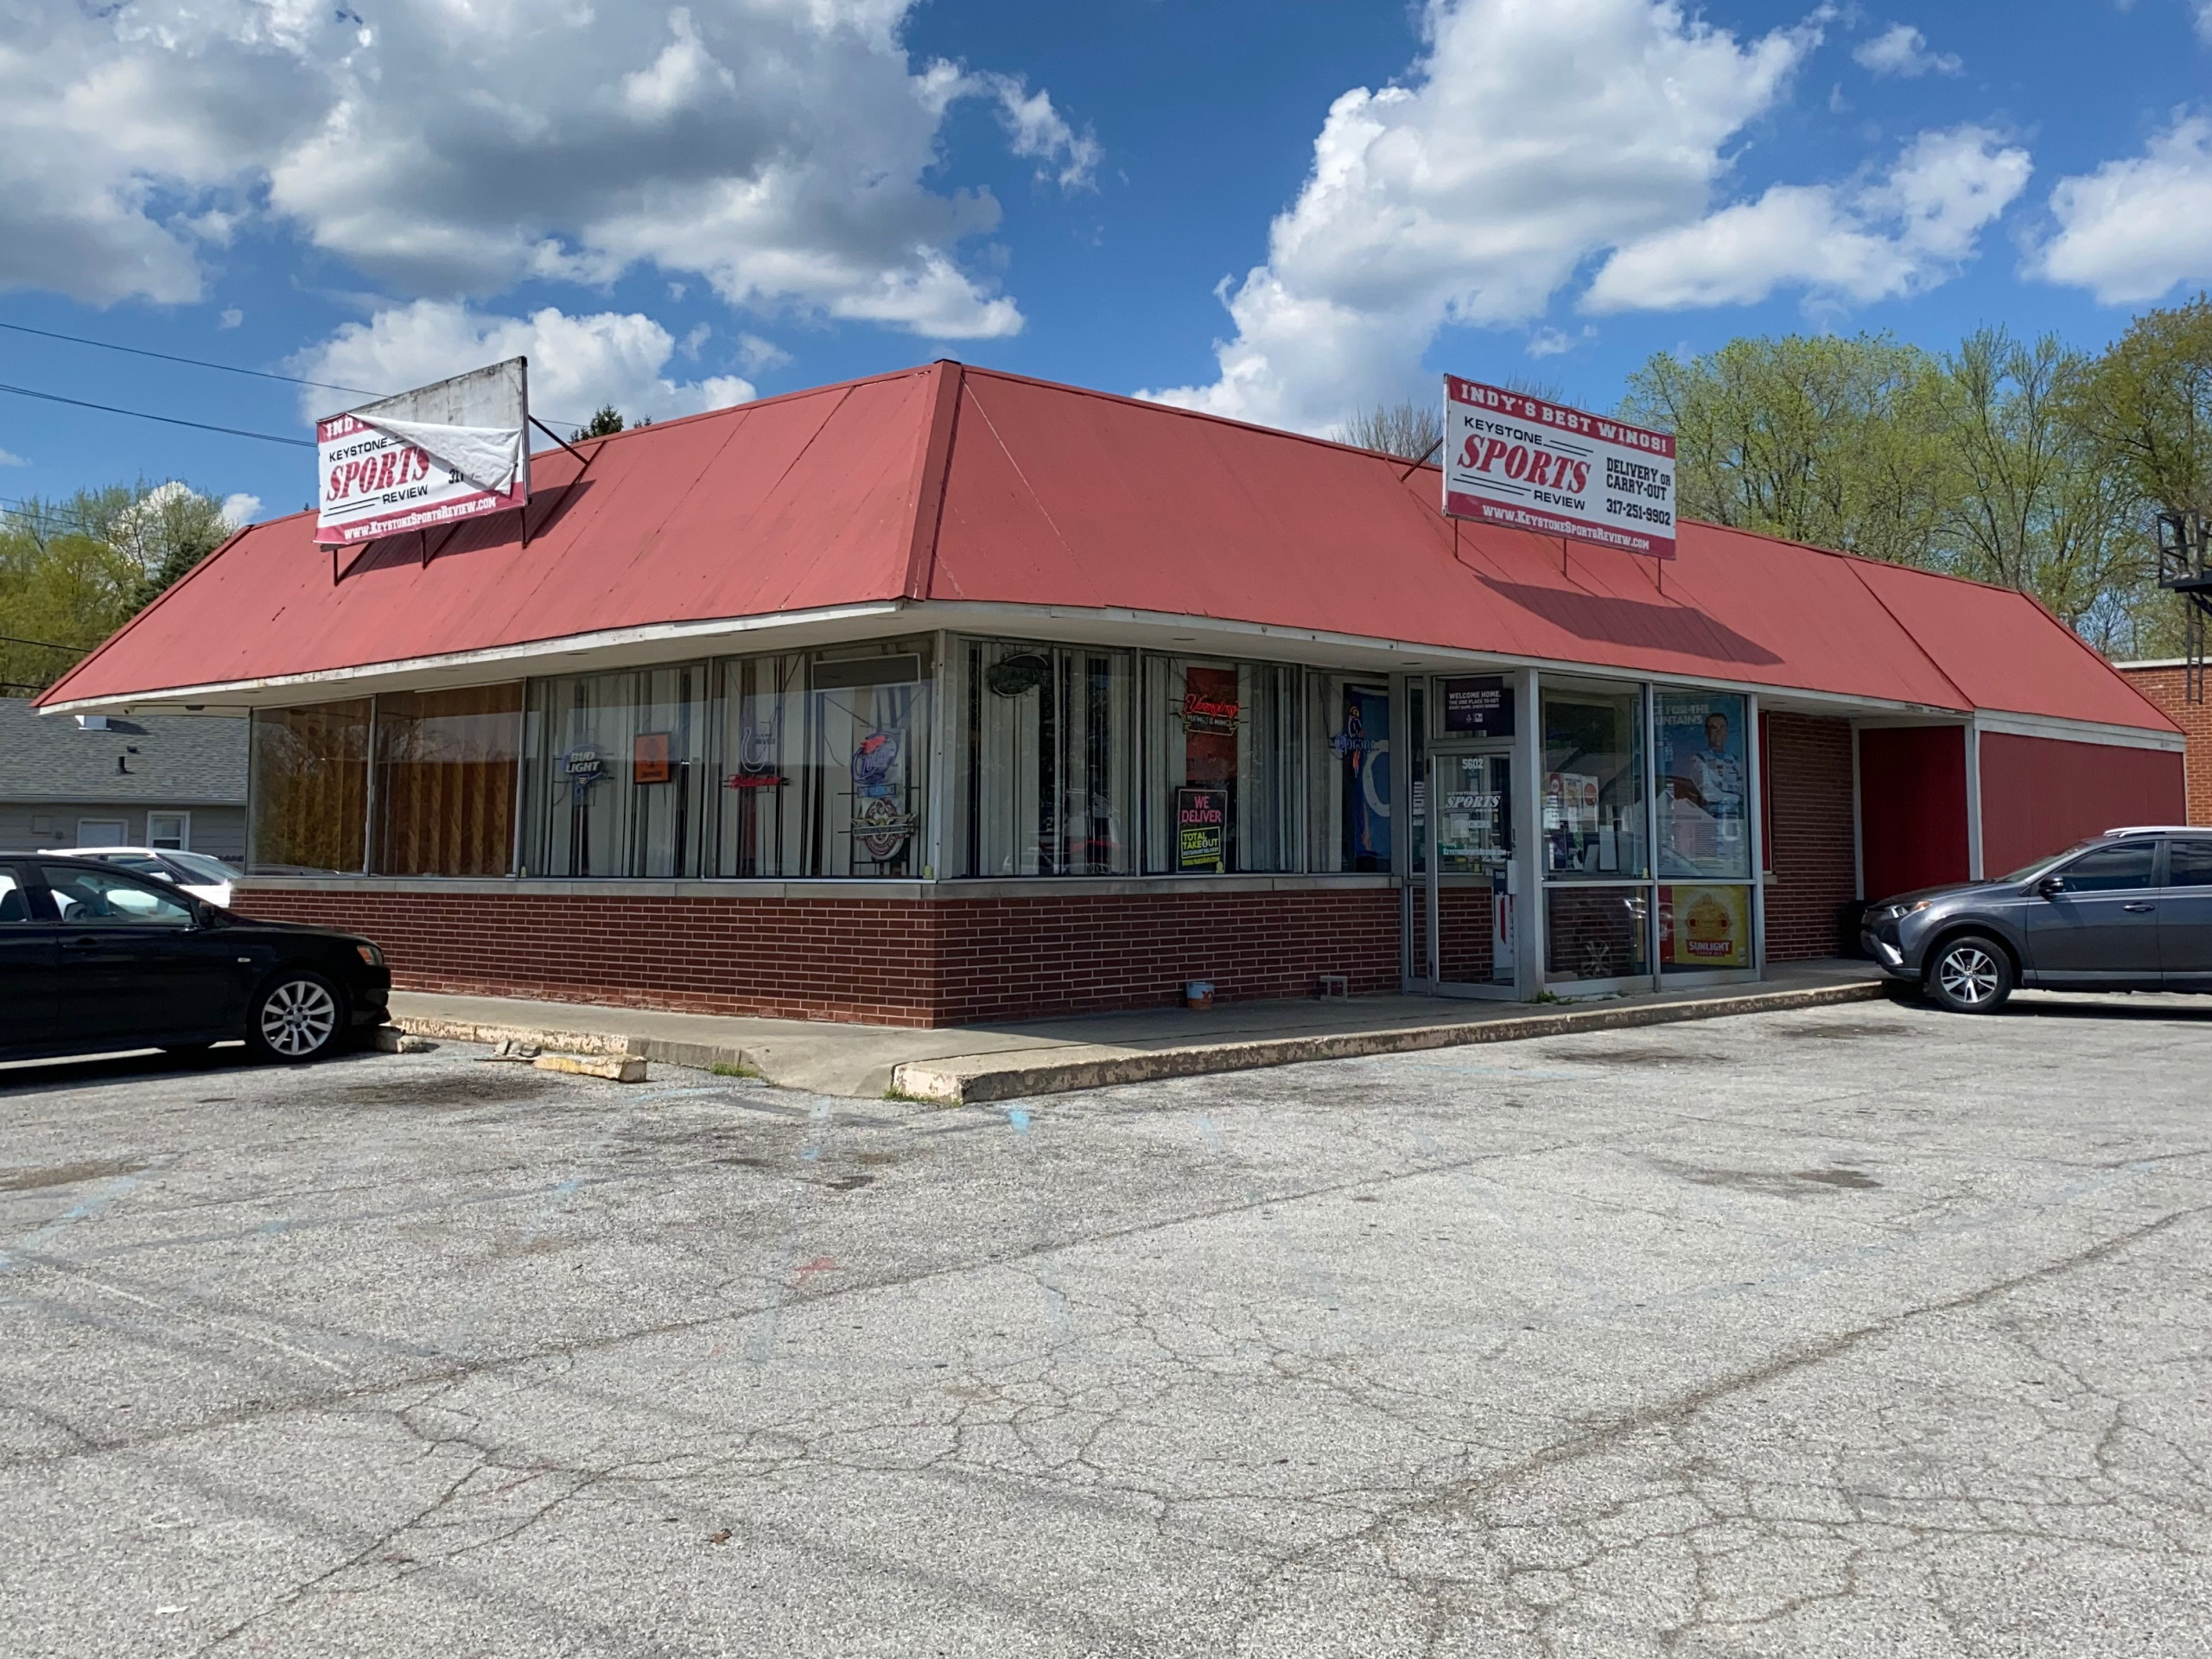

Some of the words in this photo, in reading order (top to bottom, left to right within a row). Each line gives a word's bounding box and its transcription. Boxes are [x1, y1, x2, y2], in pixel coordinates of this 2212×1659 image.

[1461, 384, 1536, 417] INDY'S
[1542, 406, 1592, 432] BEST
[1598, 422, 1667, 453] WINGS!
[1465, 416, 1542, 445] KEYSTONE
[329, 437, 388, 463] KEYSTONE
[1457, 434, 1592, 494] SPORTS
[1606, 457, 1659, 482] DELIVERY
[1660, 473, 1671, 486] OR
[326, 446, 430, 502] SPORTS
[383, 485, 429, 505] REVIEW
[1606, 474, 1668, 501] CARRY-OUT
[1534, 490, 1586, 511] REVIEW
[1606, 498, 1671, 526] 317-251-9902
[1690, 704, 1710, 714] THE
[571, 751, 596, 762] BUD
[1462, 758, 1484, 770] 5602
[565, 761, 601, 773] LIGHT
[1194, 795, 1210, 809] WE
[1445, 795, 1502, 809] SPORTS
[1181, 810, 1222, 823] DELIVER
[1182, 838, 1218, 850] TAKEOUT
[1183, 831, 1208, 842] TOTAL
[1688, 942, 1730, 951] SUNLIGHT
